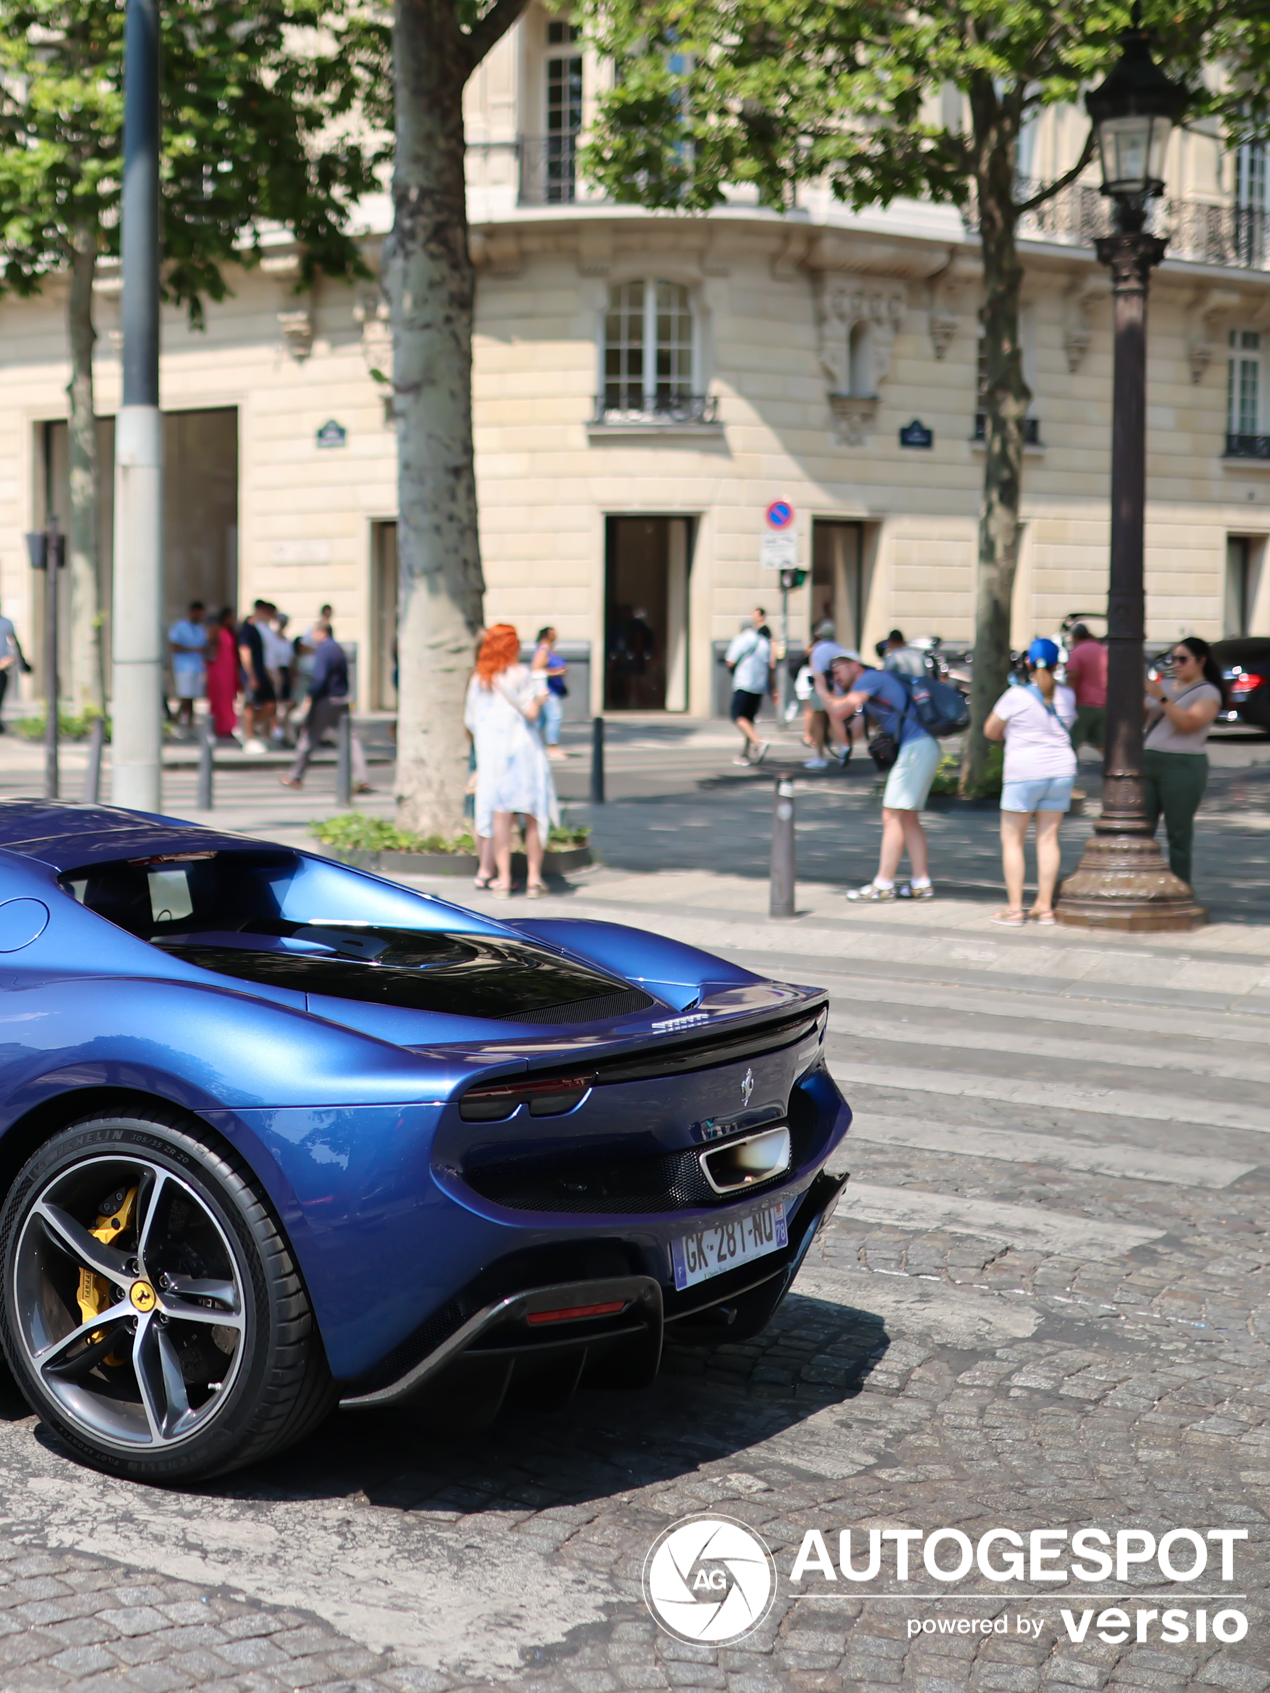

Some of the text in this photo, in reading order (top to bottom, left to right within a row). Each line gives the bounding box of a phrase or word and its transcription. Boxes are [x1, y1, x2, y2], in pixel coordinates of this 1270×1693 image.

[45, 1130, 190, 1165] MICHELIN 305/35 ZR 20
[776, 1222, 786, 1242] 78
